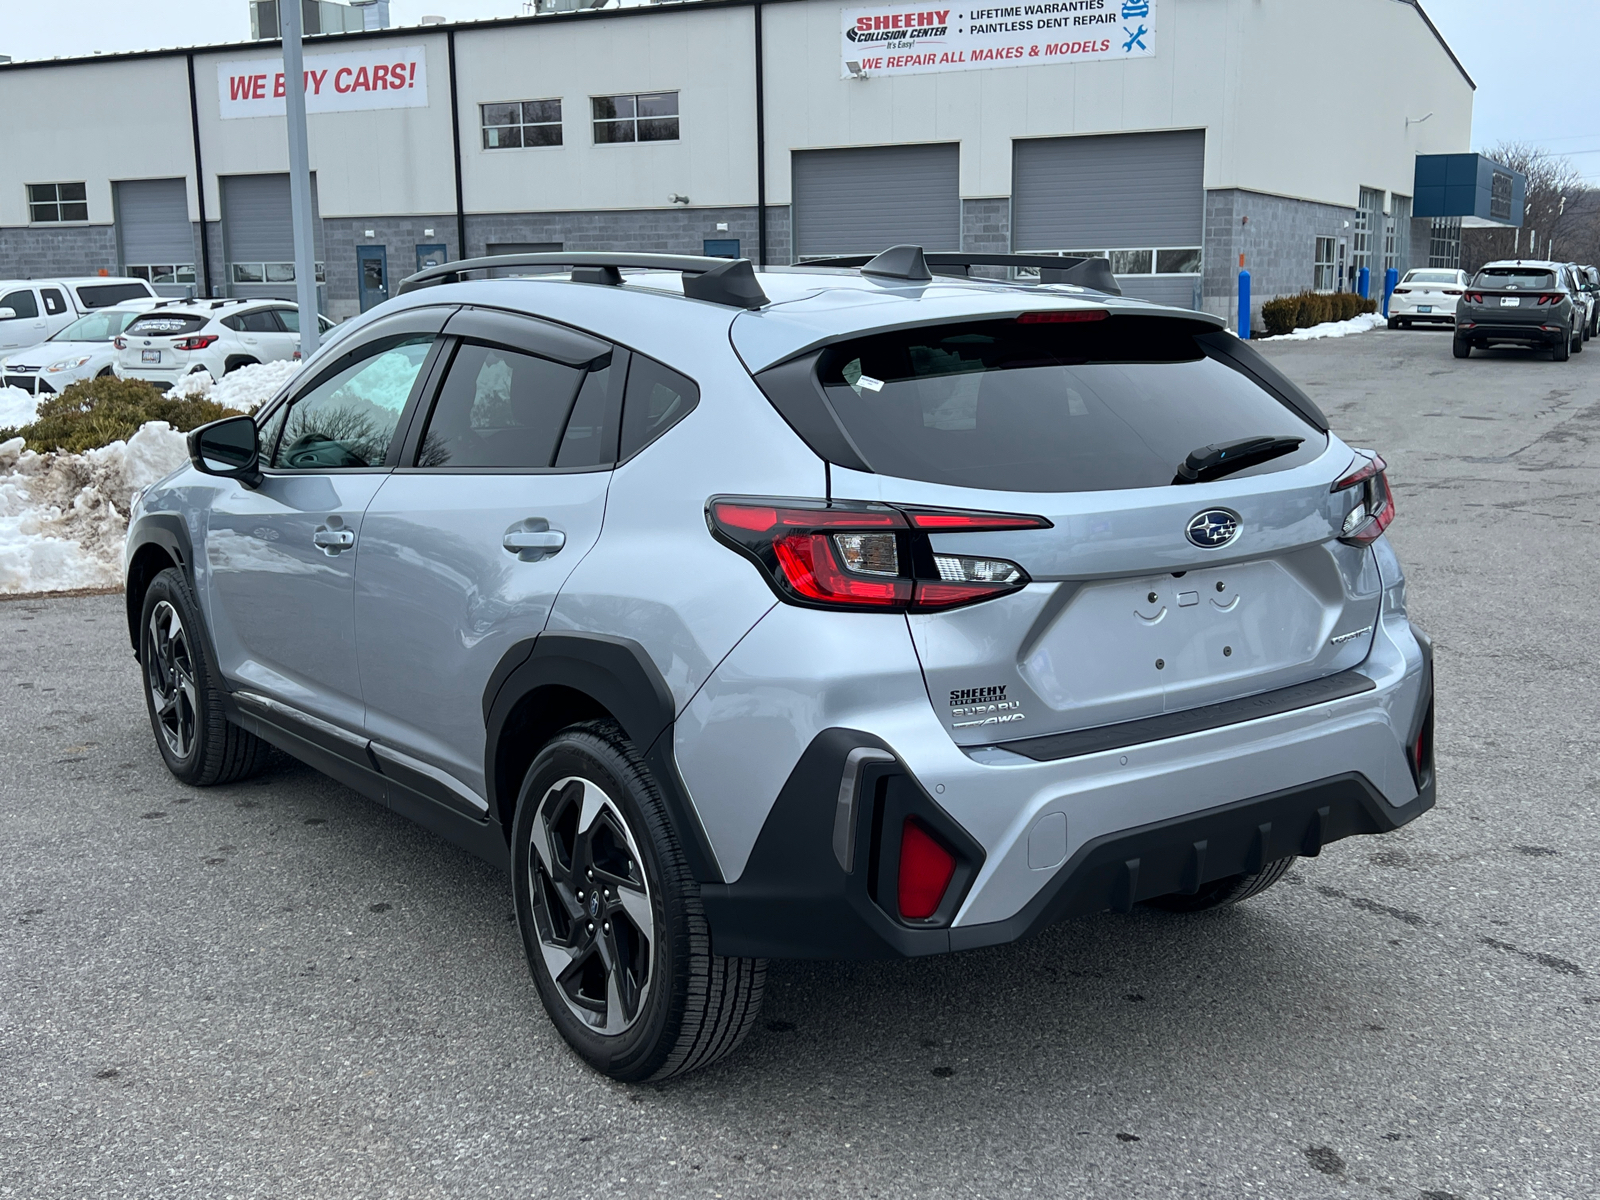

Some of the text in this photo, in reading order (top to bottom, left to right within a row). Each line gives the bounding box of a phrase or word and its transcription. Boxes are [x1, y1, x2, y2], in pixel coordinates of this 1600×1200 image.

[970, 0, 1104, 20] LIFETIME WARRANTIES
[856, 9, 950, 31] SHEEHY
[970, 13, 1117, 35] PAINTLESS DENT REPAIR
[857, 26, 948, 43] COLLISION CENTER
[886, 39, 916, 49] It's Easy!
[861, 39, 1110, 70] WE REPAIR ALL MAKES & MODELS
[229, 62, 417, 101] WE BY CARS!
[949, 684, 1007, 700] SHEEHY
[975, 695, 1005, 704] STORES
[952, 700, 1020, 717] SUBARU
